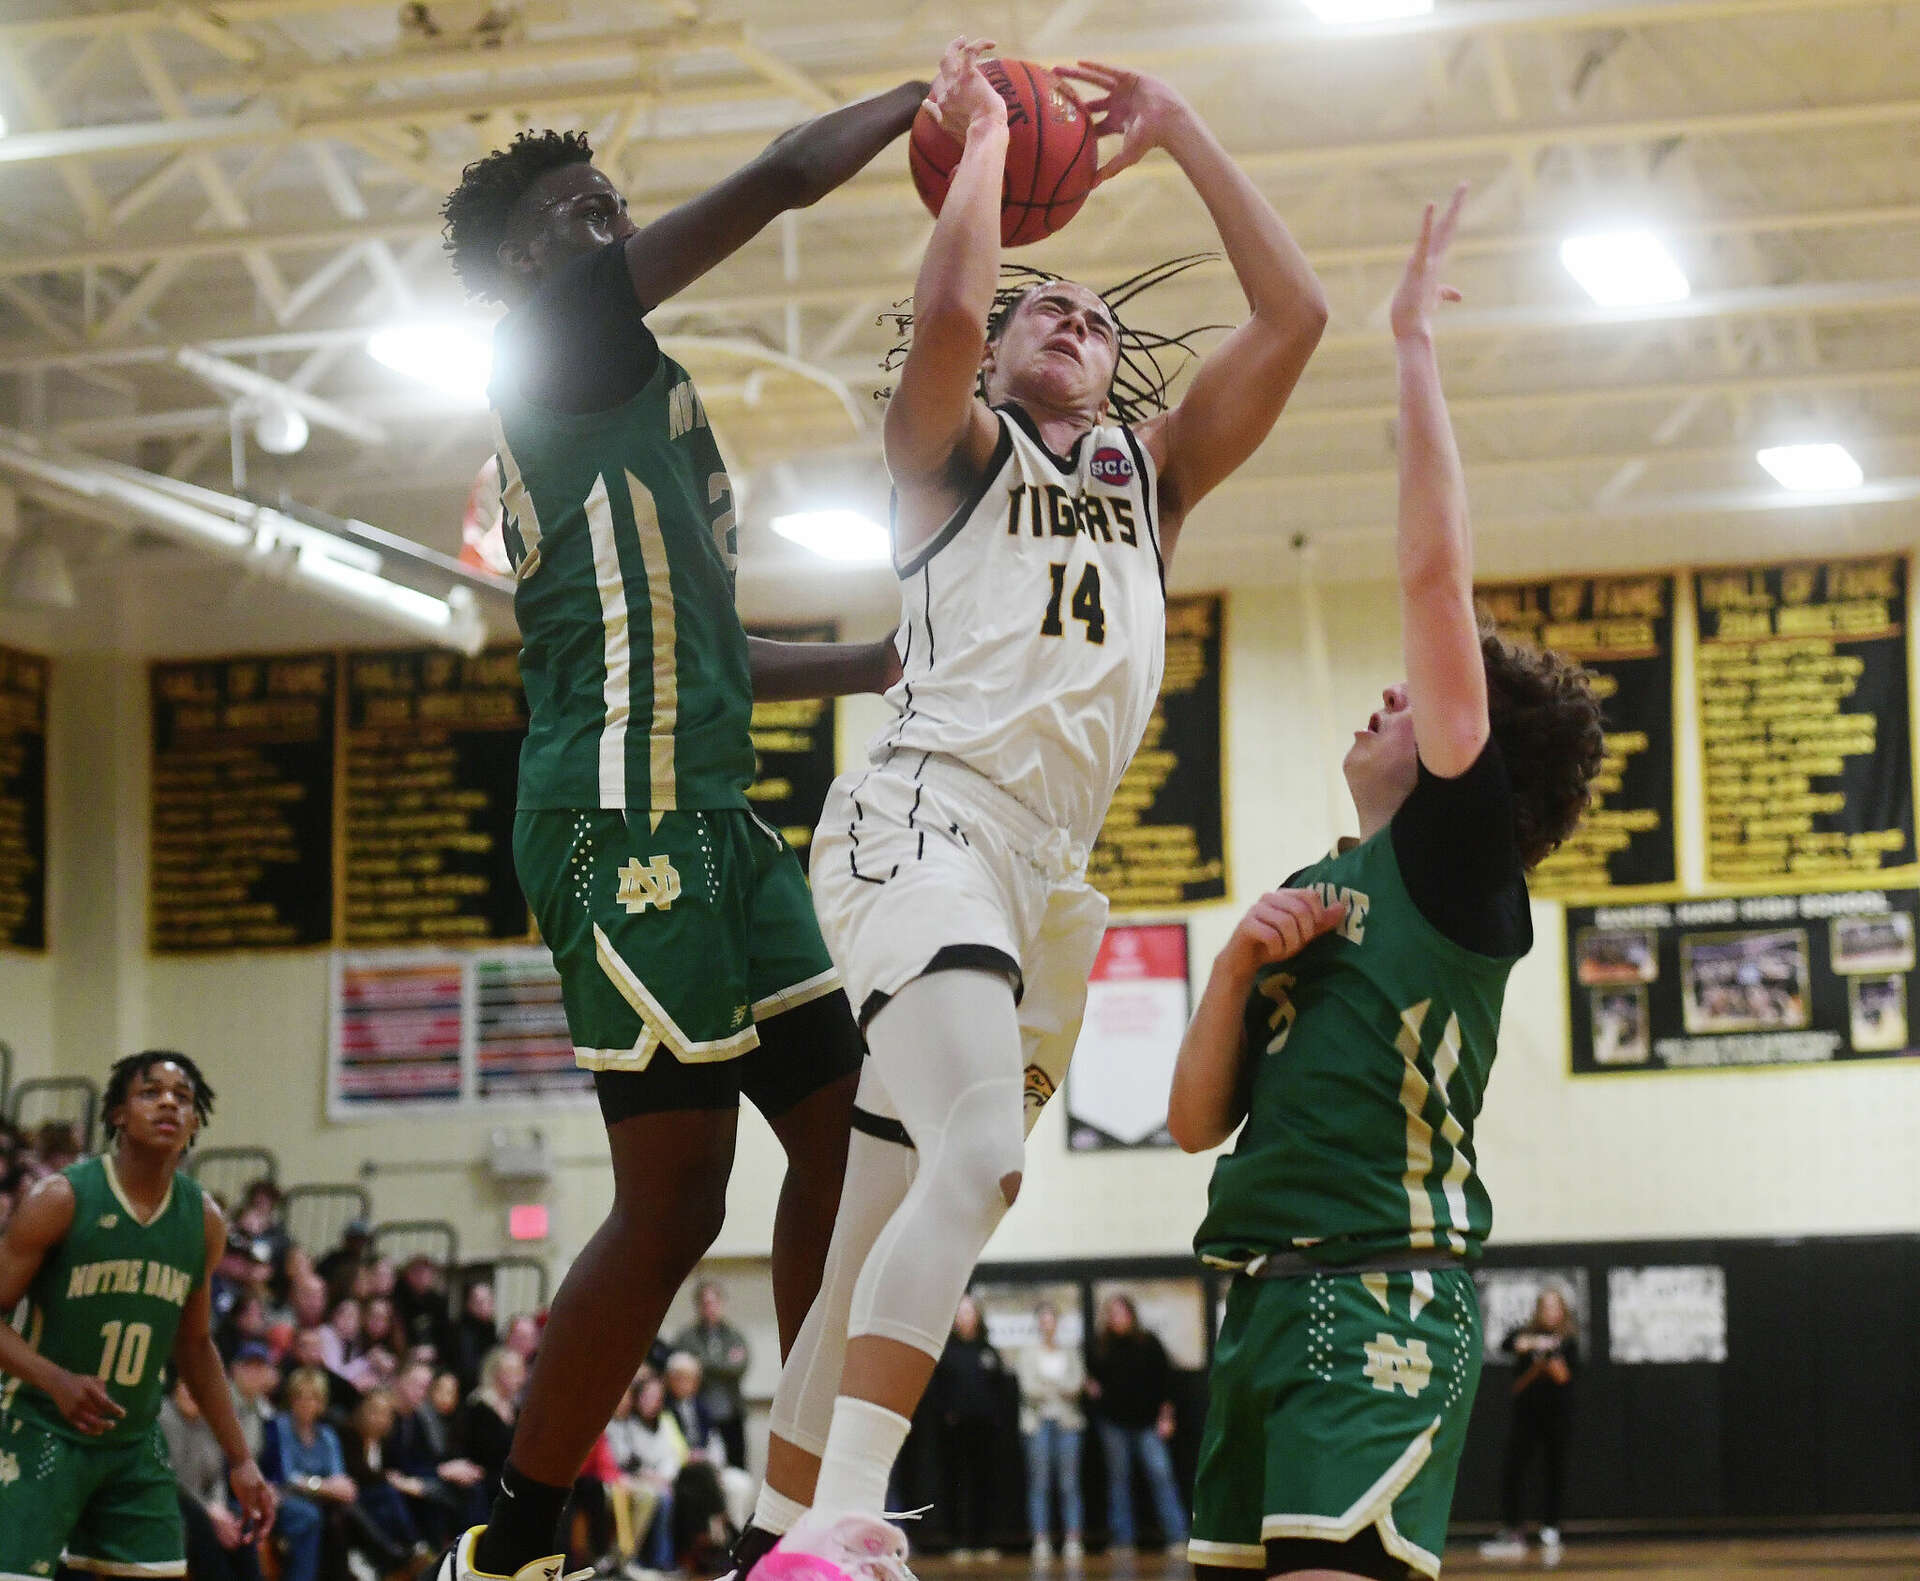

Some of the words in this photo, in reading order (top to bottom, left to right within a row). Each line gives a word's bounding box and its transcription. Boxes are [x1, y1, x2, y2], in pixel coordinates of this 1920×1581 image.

[1090, 458, 1133, 478] SCC
[1040, 561, 1106, 645] 14
[66, 1259, 144, 1299] NOTRE
[98, 1320, 152, 1386] 10
